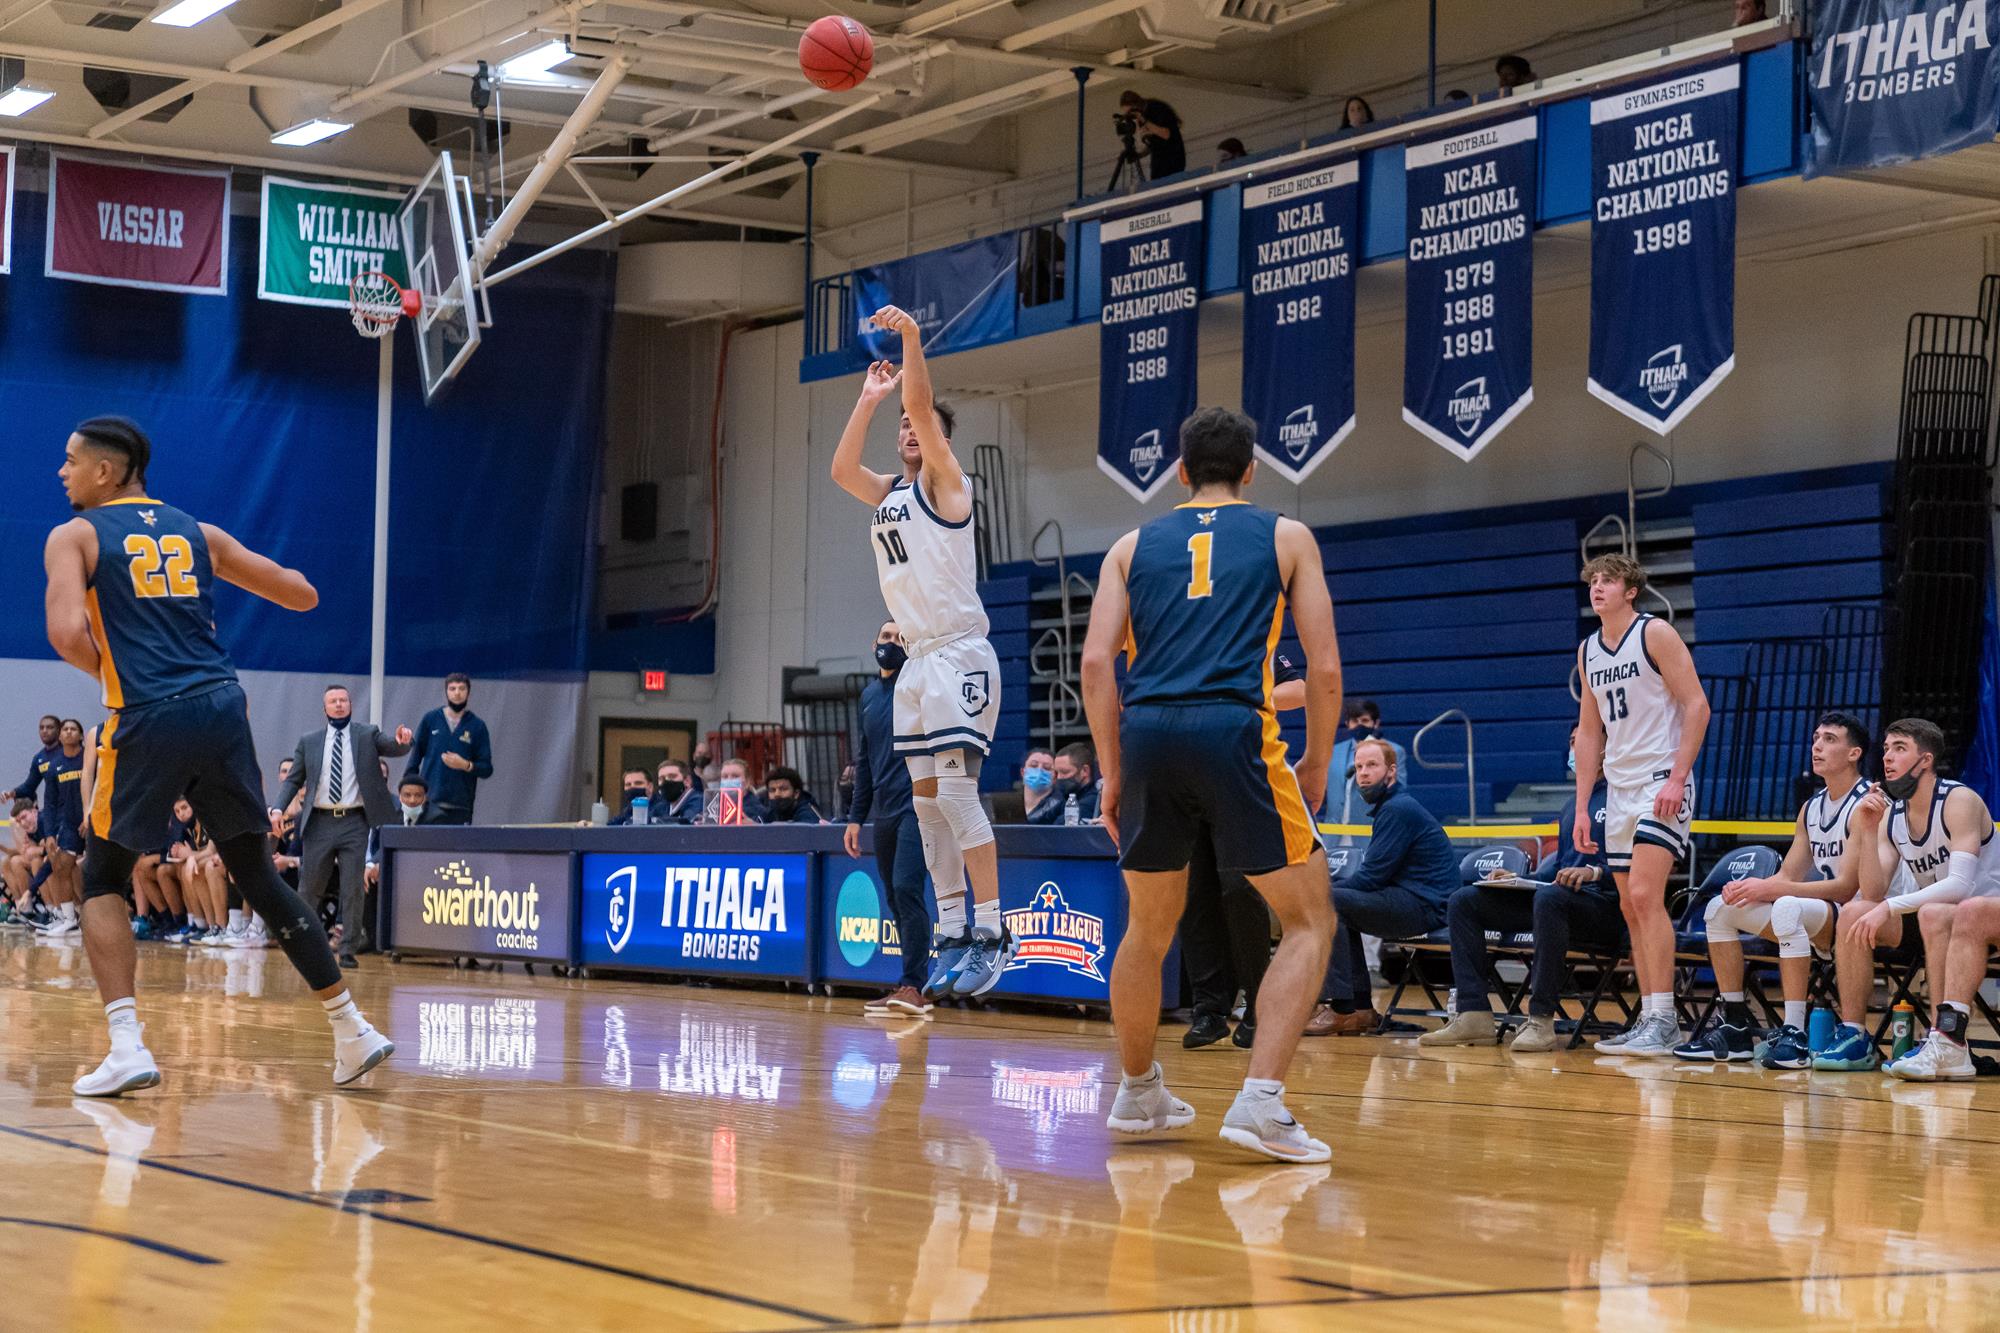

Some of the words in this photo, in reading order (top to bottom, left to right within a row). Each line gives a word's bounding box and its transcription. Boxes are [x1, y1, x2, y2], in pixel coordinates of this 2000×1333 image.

[1817, 0, 1991, 89] ITHACA
[1624, 78, 1704, 111] GYMNASTICS
[1844, 62, 1956, 104] BOMBERS
[1443, 131, 1499, 157] FOOTBALL
[1634, 112, 1694, 151] NCGA
[1444, 161, 1498, 195] NCAA
[1607, 140, 1720, 189] NATIONAL
[1267, 182, 1295, 199] FIELD
[1296, 171, 1335, 192] HOCKEY
[1596, 170, 1729, 222] CHAMPIONS
[97, 201, 184, 249] VASSAR
[1128, 212, 1172, 233] BASEBALL
[1277, 201, 1324, 233] NCAA
[1420, 186, 1519, 231] NATIONAL
[297, 203, 399, 251] WILLIAM
[1409, 214, 1526, 262] CHAMPIONS
[1633, 219, 1692, 256] 1998
[1129, 238, 1170, 267] NCAA
[1258, 226, 1344, 266] NATIONAL
[309, 246, 385, 290] SMITH
[1110, 261, 1187, 297] NATIONAL
[1252, 253, 1349, 296] CHAMPIONS
[1444, 260, 1495, 293] 1979
[1102, 287, 1198, 325] CHAMPIONS
[1276, 295, 1322, 326] 1982
[1443, 293, 1494, 326] 1988
[1128, 327, 1167, 354] 1980
[1442, 327, 1495, 360] 1991
[1127, 356, 1167, 384] 1988
[1639, 362, 1688, 388] ITHACA
[1447, 393, 1491, 417] ITHACA
[1279, 421, 1318, 442] ITHACA
[1130, 445, 1163, 463] ITHACA
[877, 529, 908, 564] 10
[123, 534, 199, 598] 22
[1187, 531, 1213, 599] 1
[1590, 661, 1640, 688] ITHACA
[1606, 687, 1629, 722] 13
[423, 875, 540, 931] swarthout
[661, 867, 788, 933] ITHACA
[496, 929, 538, 951] coaches
[840, 916, 879, 943] NCAA
[1053, 912, 1101, 946] LEAGUE
[681, 933, 760, 961] BOMBERS
